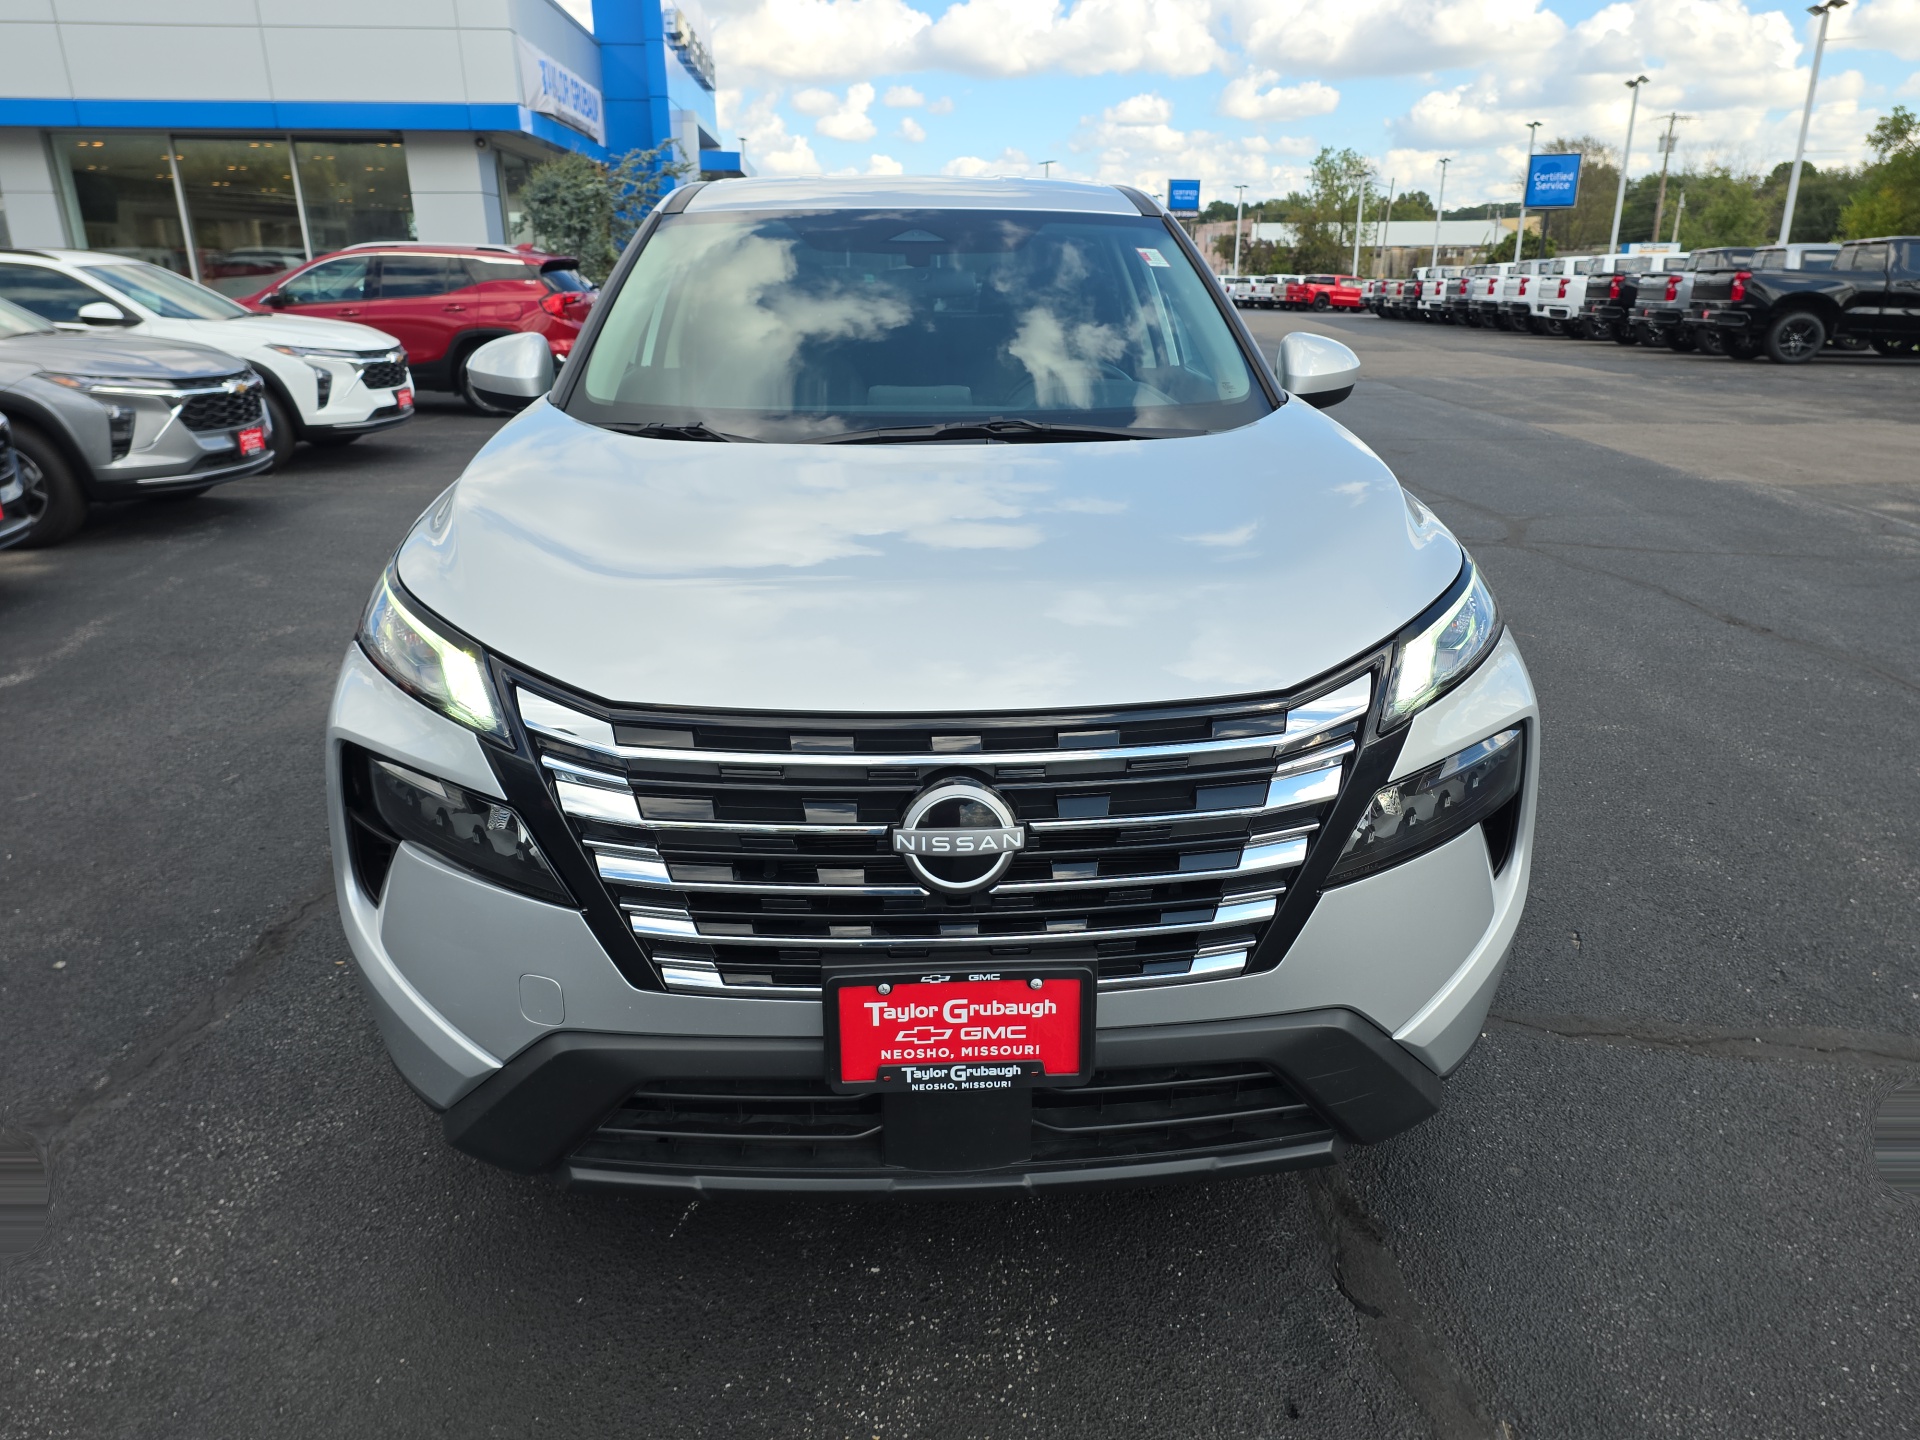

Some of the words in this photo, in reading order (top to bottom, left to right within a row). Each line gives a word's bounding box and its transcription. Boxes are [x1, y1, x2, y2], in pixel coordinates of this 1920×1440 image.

[1533, 171, 1575, 182] Certified
[1535, 181, 1571, 190] Service
[896, 831, 1021, 852] NISSAN
[968, 973, 1001, 981] GMC
[863, 1001, 939, 1027] Taylor
[942, 998, 1057, 1024] Grubaugh
[959, 1025, 1027, 1040] GMC
[880, 1047, 955, 1060] NEOSHO,
[961, 1044, 1041, 1057] MISSOURI
[901, 1066, 948, 1083] Taylor
[950, 1064, 1022, 1081] Grubaugh
[911, 1082, 958, 1091] NEOSHO,
[961, 1080, 1012, 1089] MISSOURI
